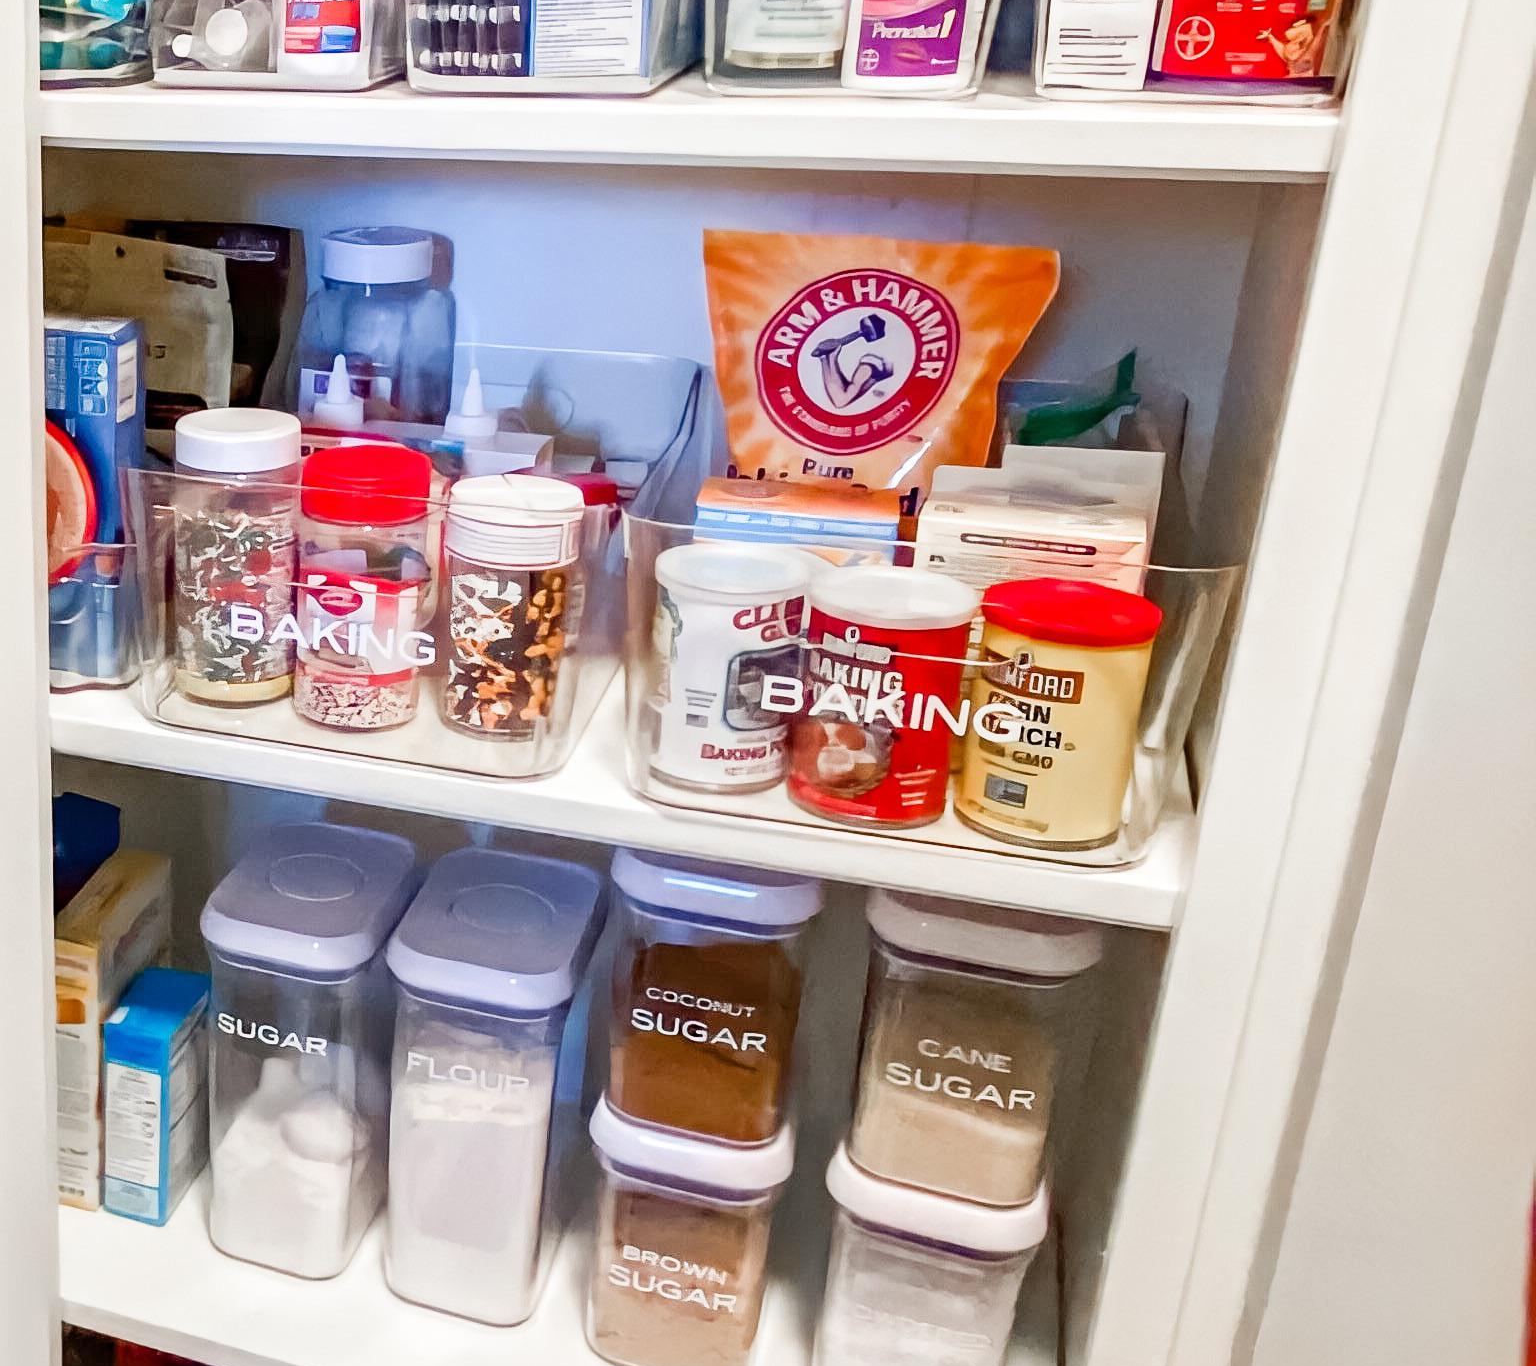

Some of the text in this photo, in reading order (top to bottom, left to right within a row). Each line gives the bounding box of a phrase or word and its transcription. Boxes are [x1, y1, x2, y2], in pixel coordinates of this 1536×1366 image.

[766, 277, 948, 381] ARM & HAMMER
[802, 458, 855, 481] Pure
[230, 604, 437, 667] BAKING
[760, 675, 1026, 744] BAKING
[645, 987, 759, 1019] COCONUT
[217, 1012, 328, 1057] SUGAR
[630, 1008, 768, 1054] SUGAR
[406, 1050, 531, 1093] FLOUR
[917, 1038, 1012, 1075] CANE
[885, 1061, 1037, 1112] SUGAR
[622, 1244, 729, 1286] BROWN
[608, 1264, 738, 1314] SUGAR
